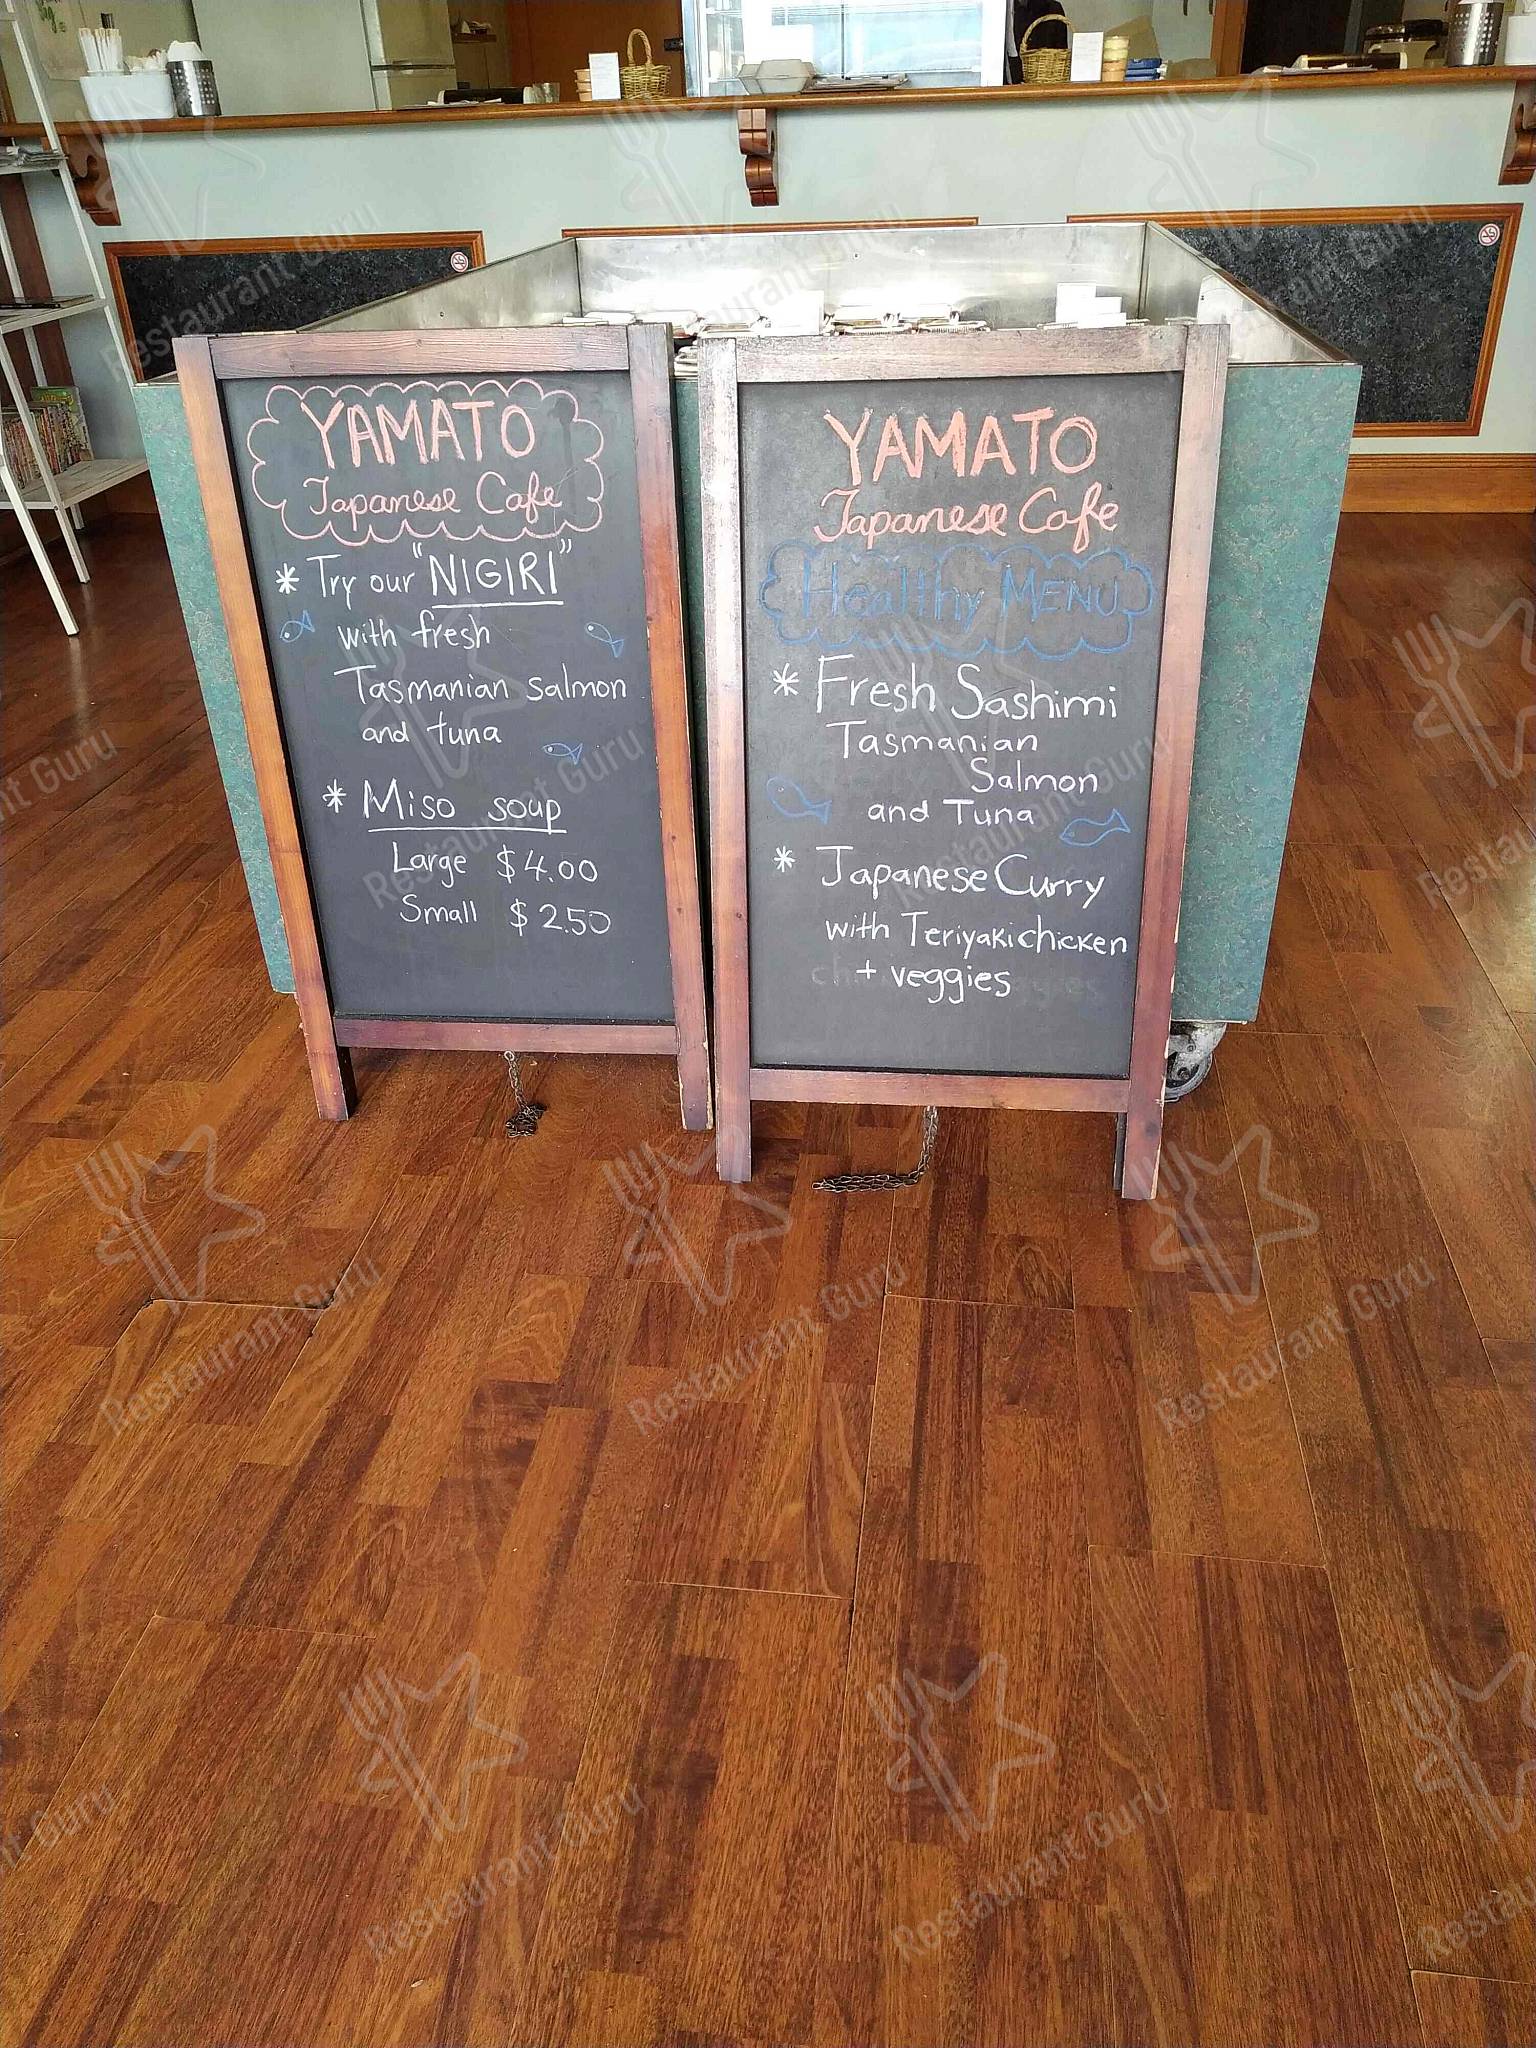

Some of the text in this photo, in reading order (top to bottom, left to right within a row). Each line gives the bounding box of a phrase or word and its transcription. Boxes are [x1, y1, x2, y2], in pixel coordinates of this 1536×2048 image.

[301, 399, 536, 469] YAMATO
[823, 407, 1098, 485] YAMATO
[303, 470, 562, 531] Japanese Cafe
[813, 481, 1119, 553] Japanese Cafe
[306, 553, 357, 609] Try
[369, 571, 415, 594] our
[337, 609, 490, 650] with fresh
[334, 664, 510, 704] Tasmanian
[816, 653, 1117, 720] Fresh Sashimi
[361, 711, 502, 745] and tuna
[826, 720, 1038, 759] Tasmanian
[970, 757, 1098, 793] Salmon
[362, 778, 562, 834] Miso soup
[867, 799, 1035, 825] and Tuna
[392, 841, 467, 888] Large
[816, 846, 1105, 909] Japanese Curry
[400, 894, 478, 926] Small
[825, 911, 890, 940] with
[890, 965, 1011, 1004] veggies
